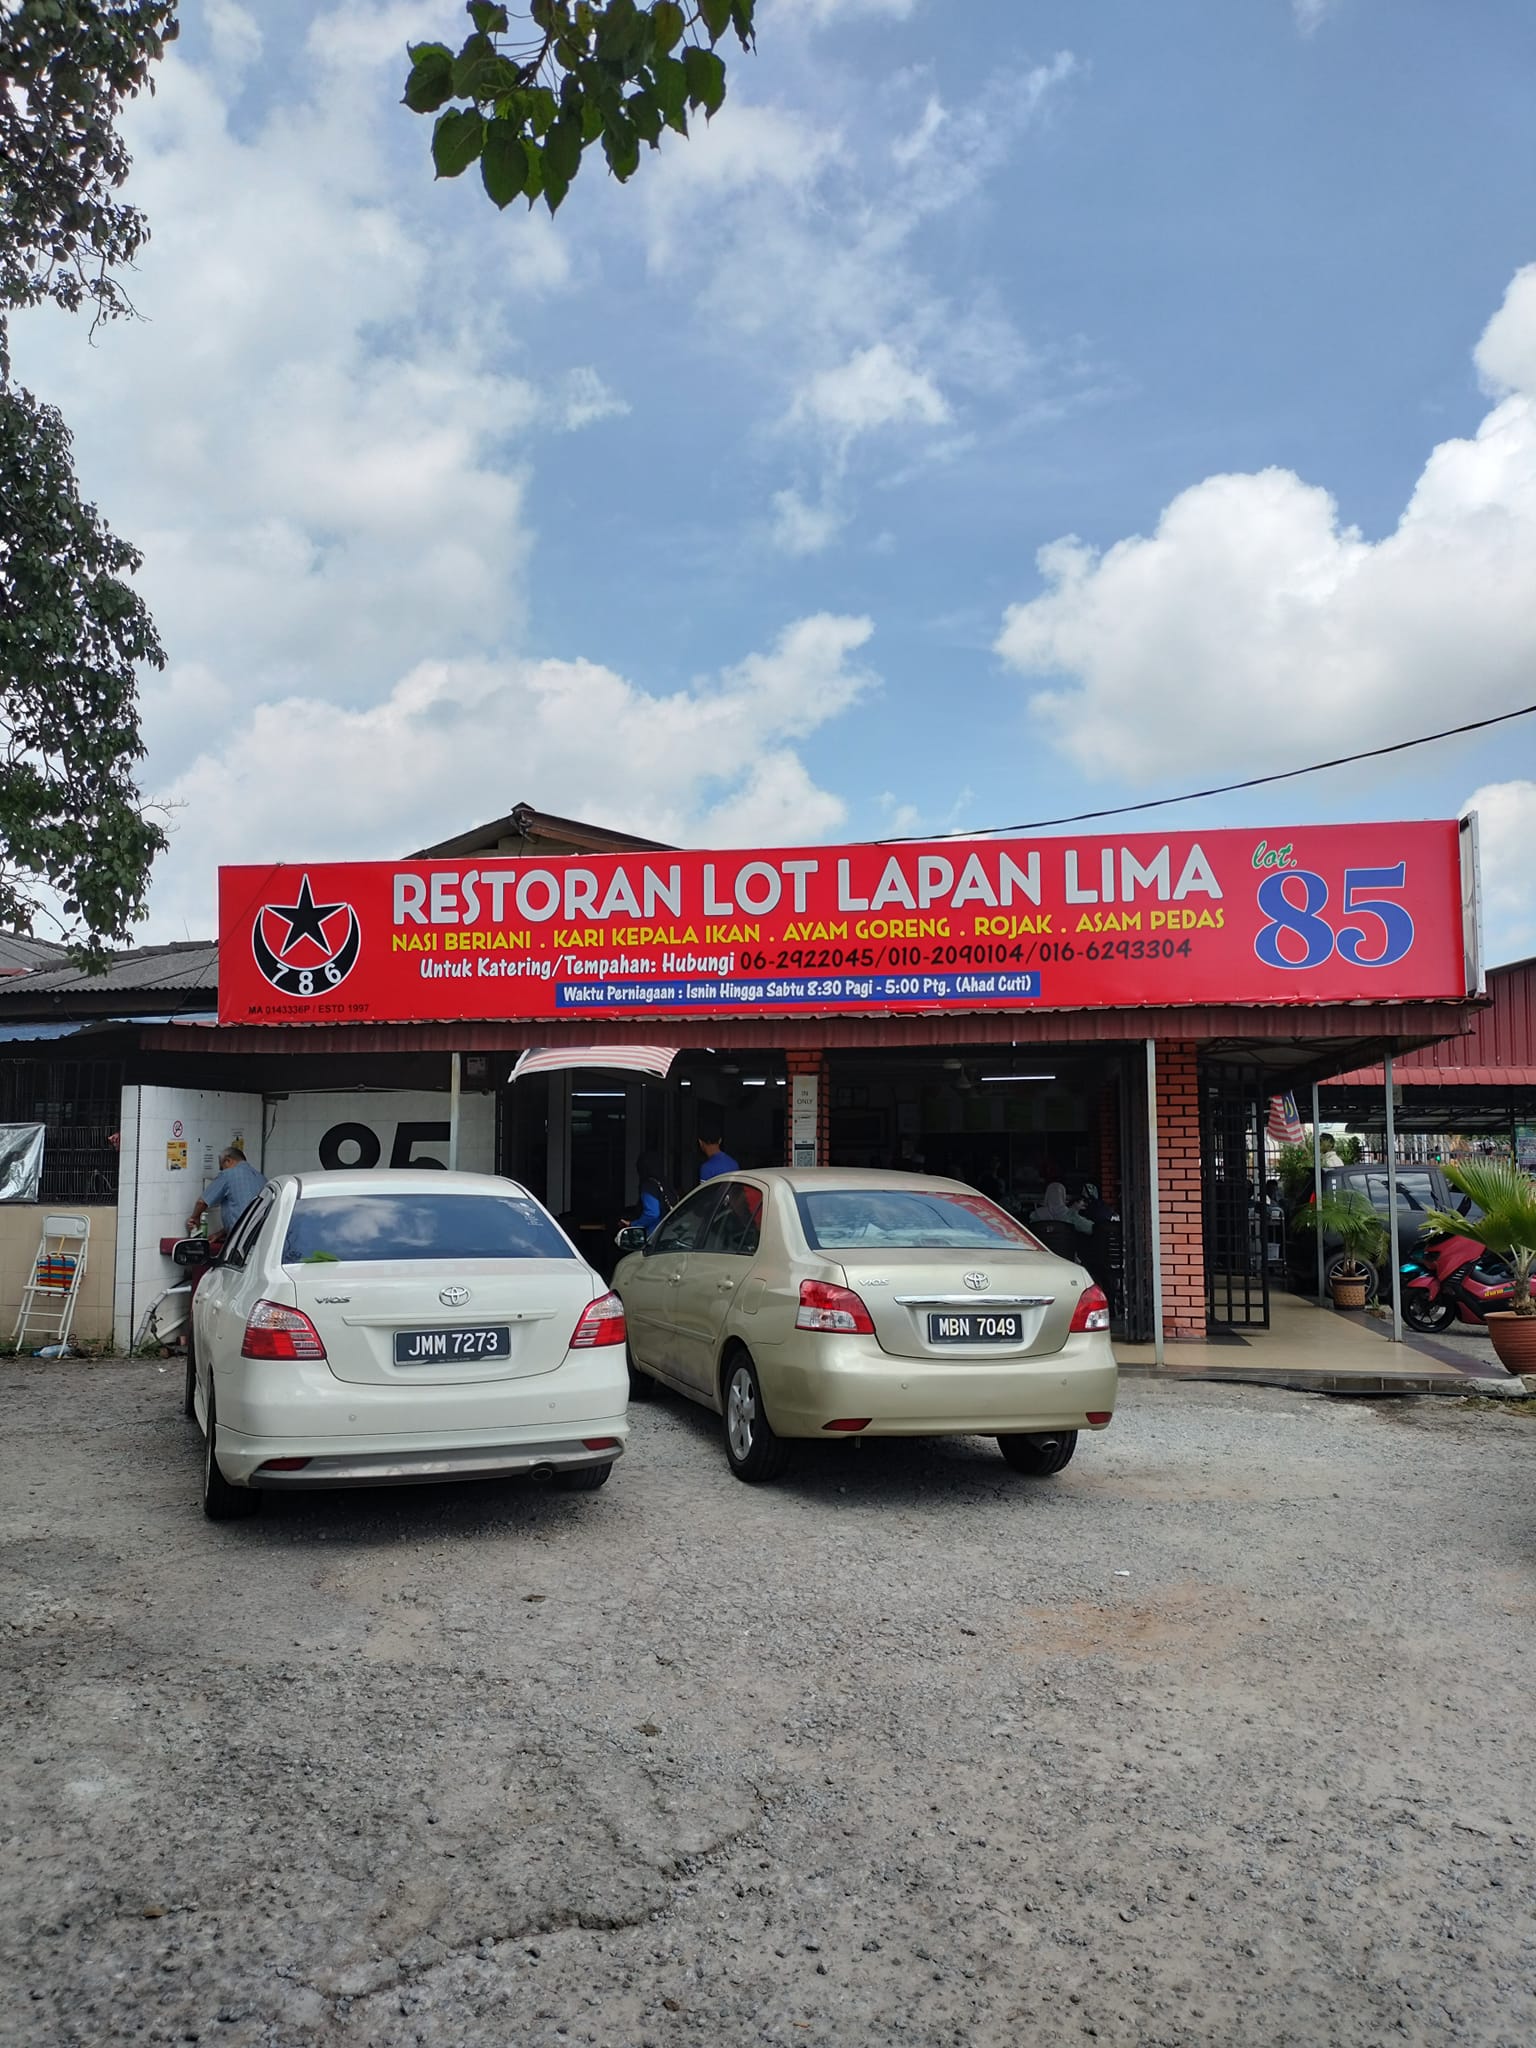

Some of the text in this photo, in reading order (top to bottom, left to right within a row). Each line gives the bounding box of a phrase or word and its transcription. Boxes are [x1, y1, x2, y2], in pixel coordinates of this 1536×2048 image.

[393, 843, 1223, 925] RESTORAN LOT LAPAN LIMA
[1253, 861, 1415, 970] 85
[392, 933, 437, 952] NASI
[444, 931, 531, 951] BERIANI
[553, 929, 603, 948] KARI
[612, 926, 699, 946] KEPALA
[705, 924, 760, 944] IKAN
[783, 921, 848, 941] AYAM
[855, 917, 950, 940] GORENG
[974, 914, 1052, 939] ROJAK
[1075, 911, 1142, 933] ASAM
[1150, 908, 1225, 930] PEDAS
[420, 958, 473, 979] Untuk
[477, 954, 656, 981] Katering/Tempahan:
[662, 952, 735, 976] Hubungi
[563, 986, 603, 1001] Waktu
[607, 984, 675, 1003] Perniagaan
[686, 983, 716, 999] Isnin
[720, 982, 763, 1001] Hingga
[766, 982, 804, 998] Sabtu
[807, 980, 842, 997] 8:30
[845, 979, 873, 998] Pagi
[884, 978, 920, 995] 5:00
[923, 977, 951, 997] Ptg.
[955, 976, 995, 994] (Ahad
[998, 975, 1032, 993] Cuti)
[248, 1006, 263, 1015] MA
[318, 1004, 345, 1013] ESTD
[348, 1003, 370, 1013] 1997
[938, 1317, 1016, 1337] MBN 7049
[407, 1331, 499, 1357] JMM 7273
